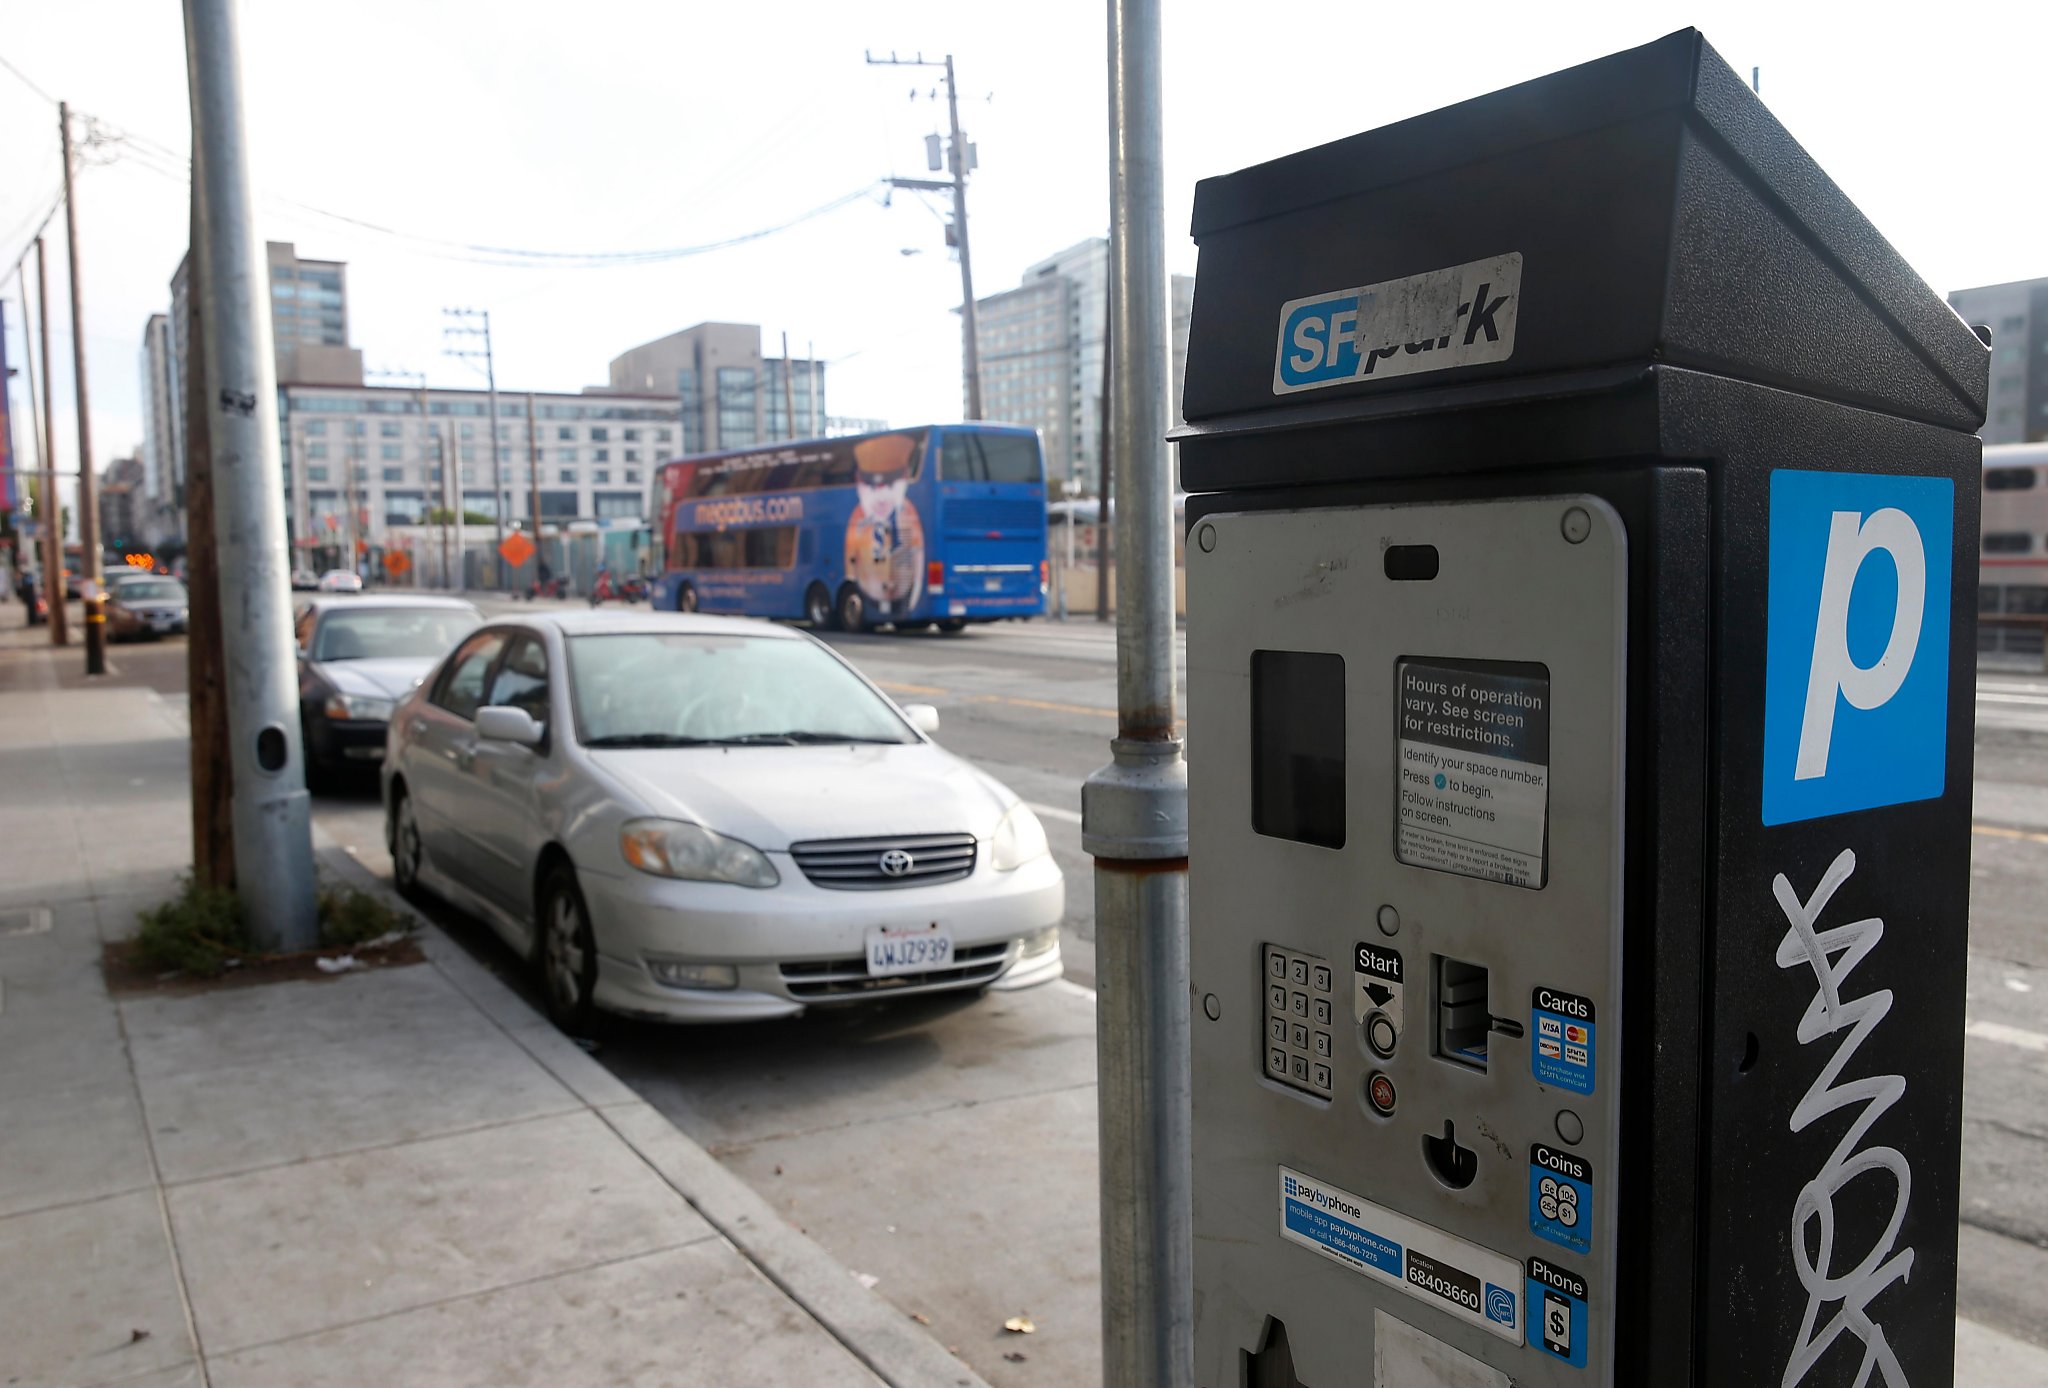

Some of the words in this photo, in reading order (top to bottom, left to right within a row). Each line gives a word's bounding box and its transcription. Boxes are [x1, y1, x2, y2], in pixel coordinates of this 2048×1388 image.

[695, 496, 803, 531] megabus.com
[1406, 675, 1447, 696] Hours
[1452, 683, 1467, 698] of
[1470, 687, 1542, 710] operation
[1405, 698, 1438, 715] vary.
[1442, 701, 1469, 719] See
[1473, 708, 1524, 728] screen
[1405, 715, 1424, 731] for
[1427, 721, 1514, 748] restrictions.
[1404, 748, 1440, 768] Identify
[1441, 757, 1464, 771] your
[1466, 763, 1498, 777] space
[1500, 768, 1544, 787] number.
[1403, 770, 1430, 786] Press
[1449, 780, 1460, 792] to
[1462, 780, 1494, 800] begin.
[1402, 790, 1434, 808] Follow
[1435, 797, 1496, 822] instructions
[1401, 808, 1413, 817] on
[1415, 810, 1452, 828] screen.
[1275, 962, 1279, 972] 1
[1359, 948, 1399, 976] Start
[1296, 967, 1302, 978] 2
[1318, 974, 1324, 985] 3
[1274, 993, 1280, 1004] 4
[1295, 1000, 1301, 1010] 5
[1539, 990, 1588, 1018] Cards
[1318, 1006, 1324, 1017] 6
[1274, 1025, 1280, 1035] 7
[1296, 1031, 1302, 1041] 8
[1542, 1022, 1560, 1034] VISA
[1318, 1039, 1324, 1049] 9
[1540, 1042, 1560, 1052] DISCOVER
[1567, 1047, 1586, 1058] SFMTA
[1296, 1063, 1302, 1073] 0
[1318, 1071, 1325, 1082] #
[1537, 1147, 1583, 1178] Coins
[1298, 1184, 1361, 1219] paybyphone
[1561, 1207, 1572, 1219] $1
[1289, 1204, 1313, 1220] mobile
[1314, 1214, 1328, 1227] app
[1330, 1222, 1397, 1258] paybyphone.com
[1309, 1227, 1316, 1235] or
[1316, 1230, 1327, 1240] call
[1410, 1254, 1434, 1271] location
[1532, 1260, 1583, 1296] Phone
[1409, 1266, 1479, 1309] 68403660
[1549, 1310, 1565, 1337] $
